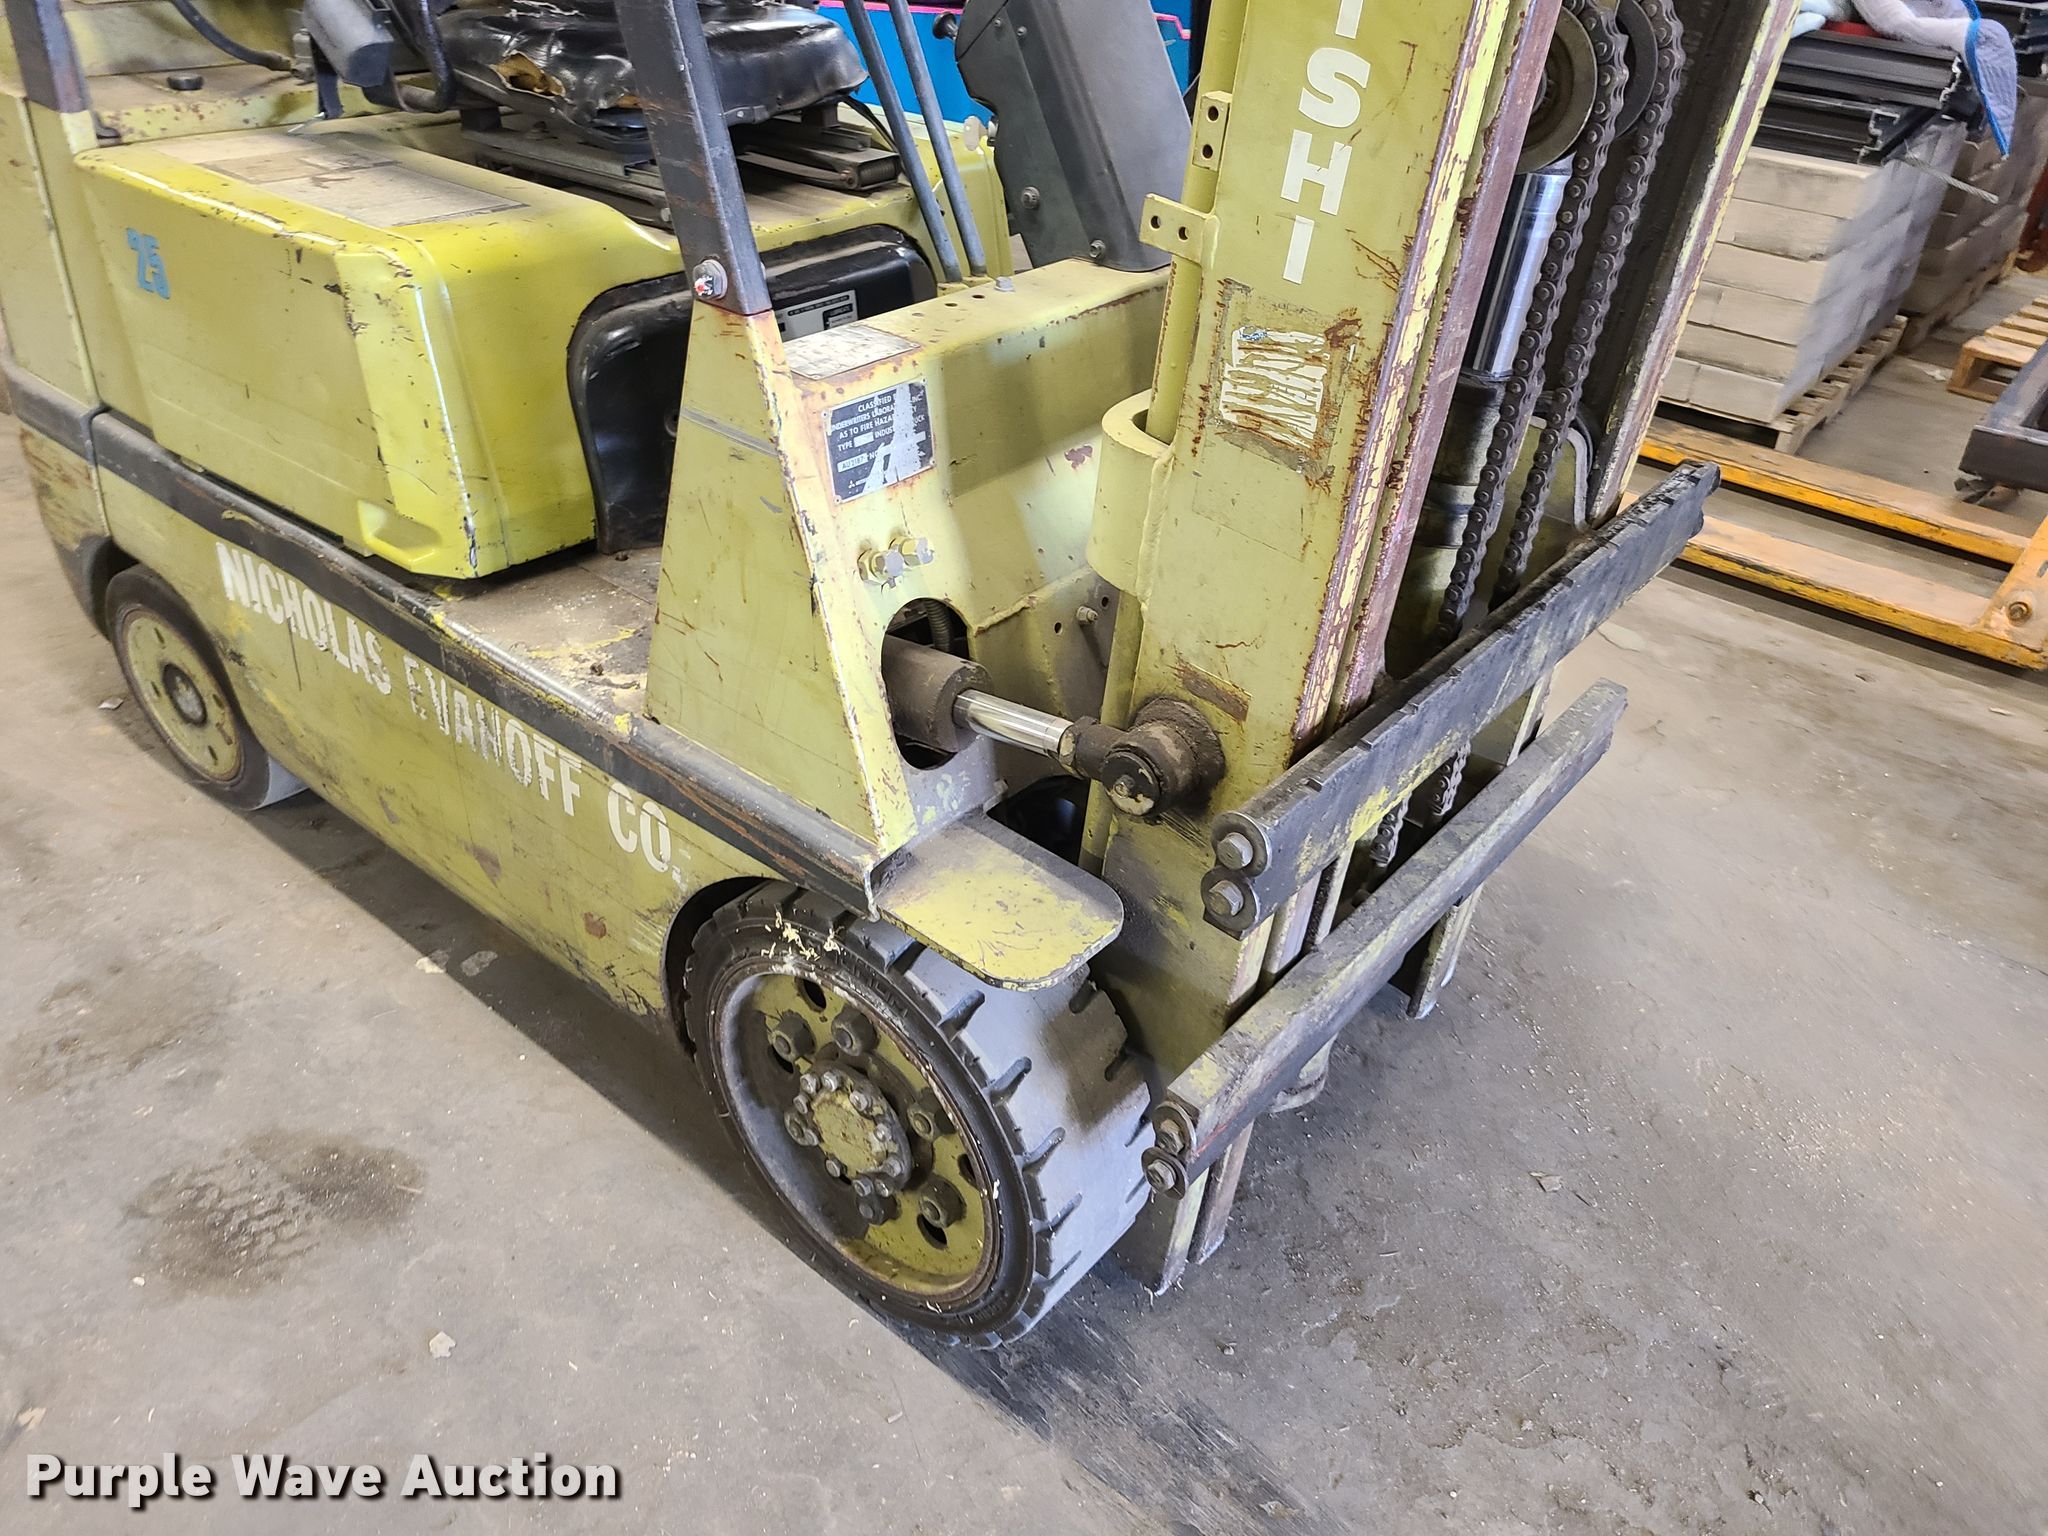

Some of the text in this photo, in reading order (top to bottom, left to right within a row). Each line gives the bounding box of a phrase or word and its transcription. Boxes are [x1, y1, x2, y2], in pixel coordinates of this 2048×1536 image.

[126, 227, 170, 300] 25
[857, 395, 892, 413] CLASSIFIED
[831, 412, 871, 431] NDERWRITERS
[839, 431, 849, 440] AS
[849, 426, 859, 435] TO
[860, 422, 874, 432] FIRE
[837, 440, 853, 452] TYPE
[215, 541, 392, 696] NICHOLAS
[403, 655, 584, 817] EVANOFF
